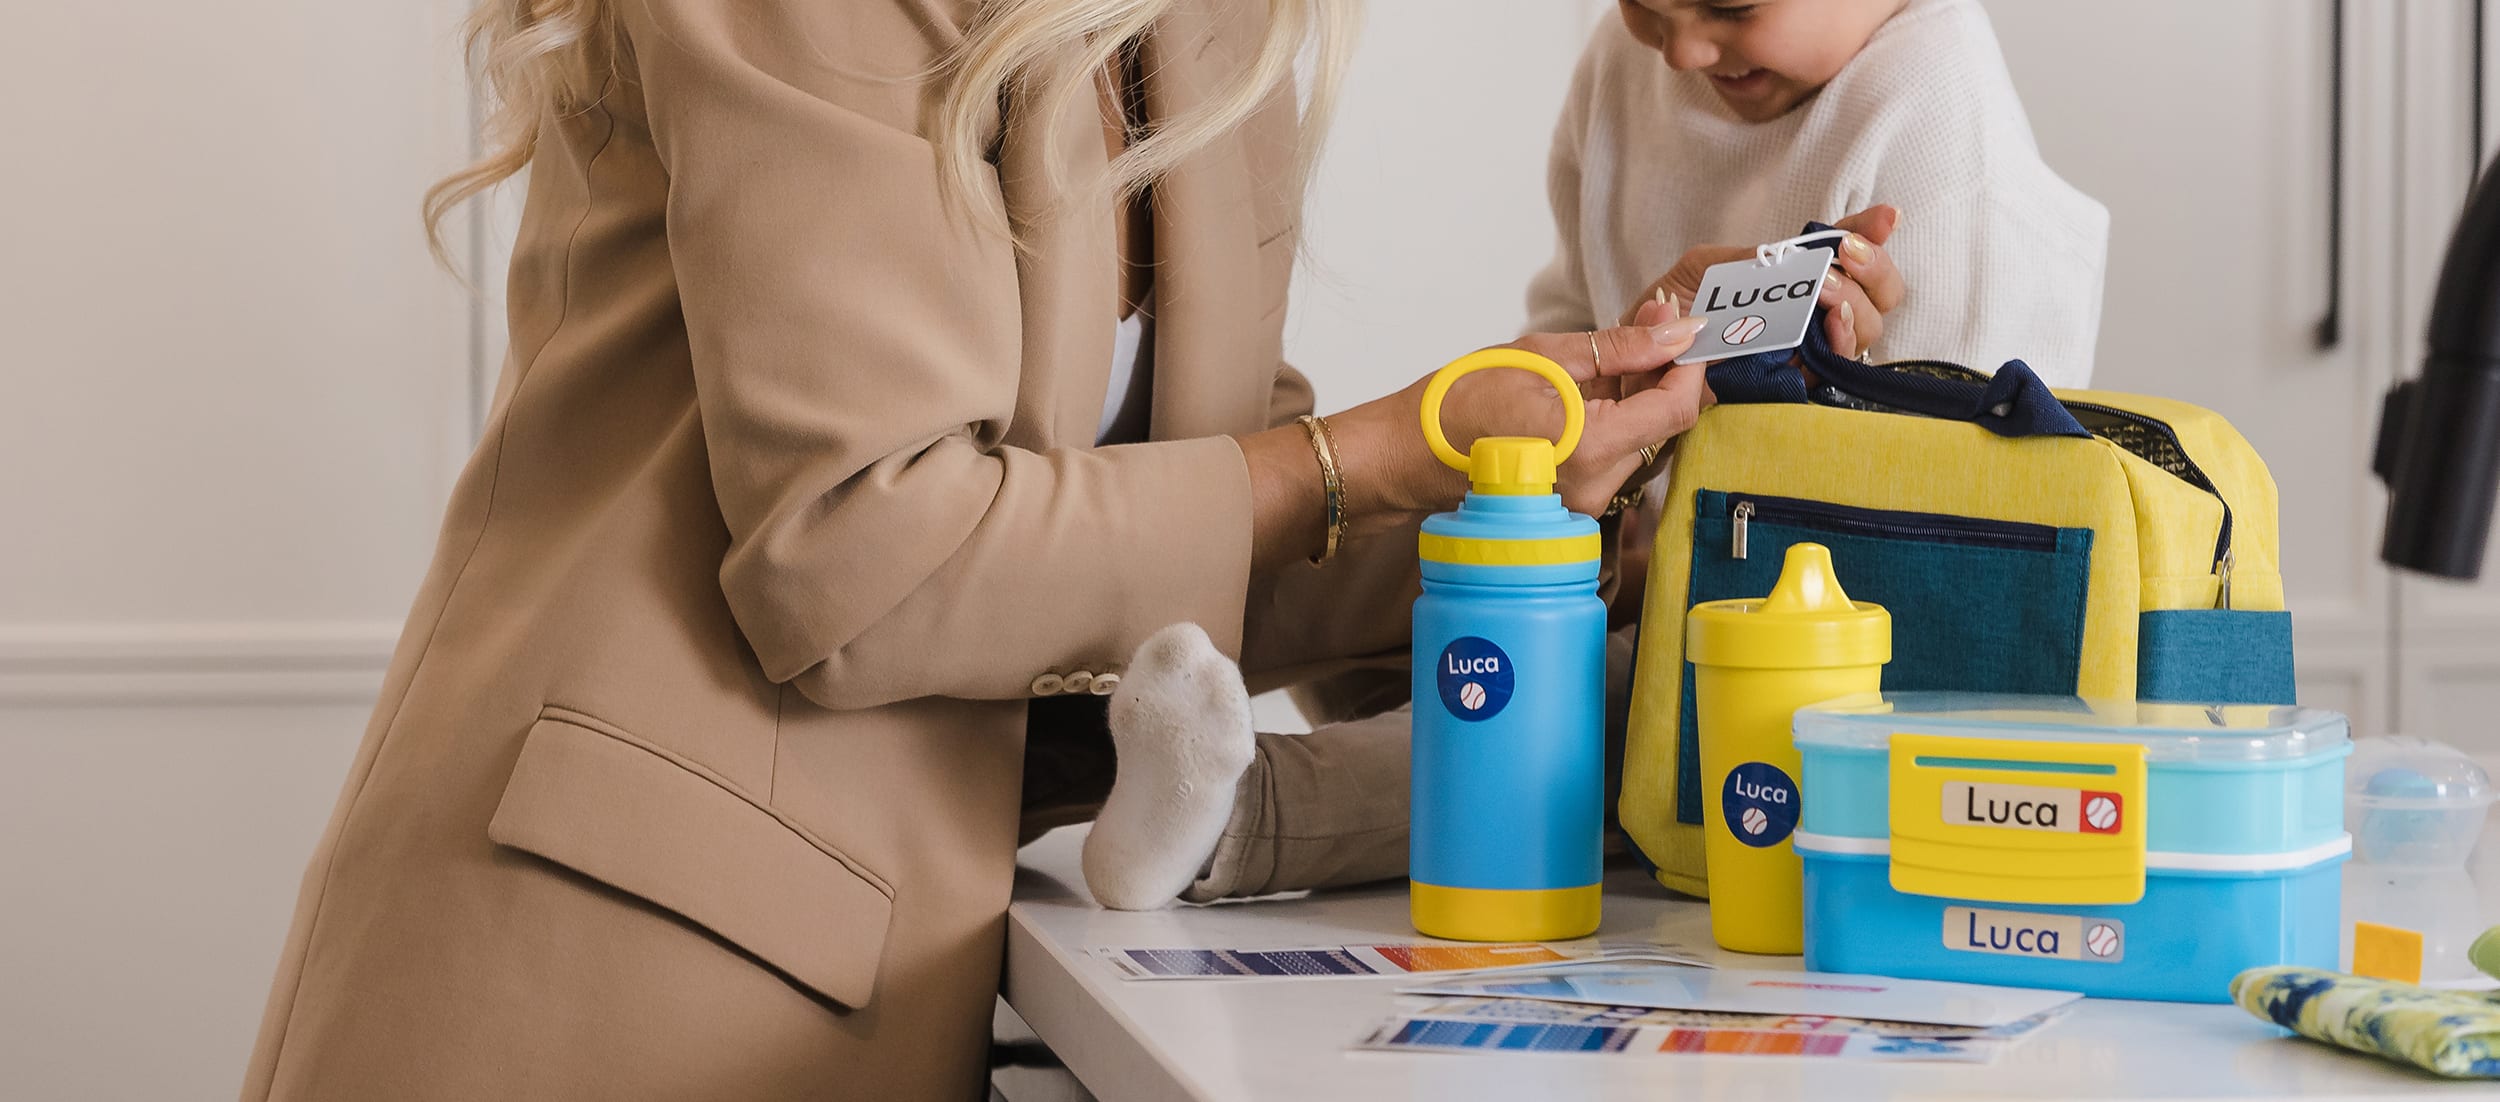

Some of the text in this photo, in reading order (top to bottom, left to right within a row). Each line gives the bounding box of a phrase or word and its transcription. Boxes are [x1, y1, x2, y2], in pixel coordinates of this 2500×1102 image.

[1705, 279, 1817, 313] Luca
[1448, 652, 1499, 675] Luca
[1735, 773, 1788, 805] Luca
[1967, 786, 2058, 827] Luca
[1969, 912, 2059, 954] Luca
